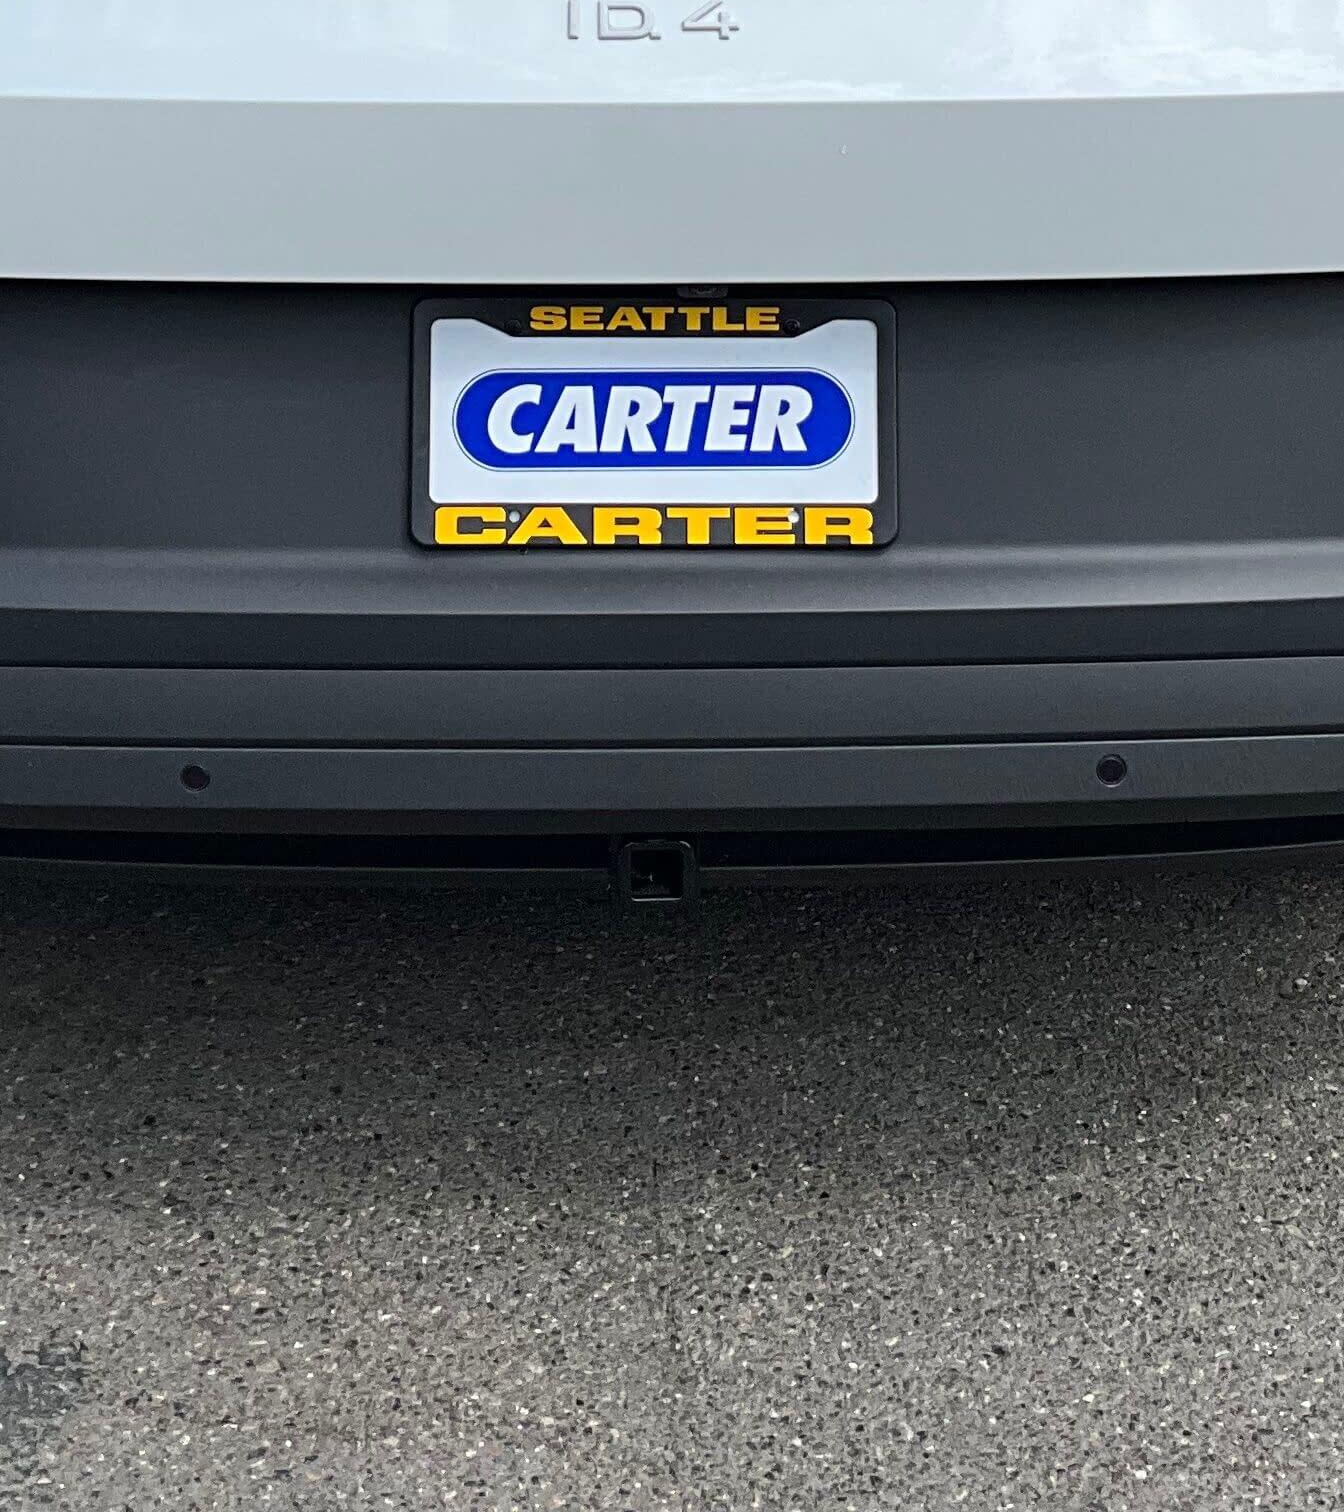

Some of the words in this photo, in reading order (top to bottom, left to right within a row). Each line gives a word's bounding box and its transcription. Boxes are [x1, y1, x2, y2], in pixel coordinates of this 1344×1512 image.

[529, 305, 781, 332] SEATTLE
[487, 383, 813, 455] CARTER
[433, 506, 875, 546] CARTER
